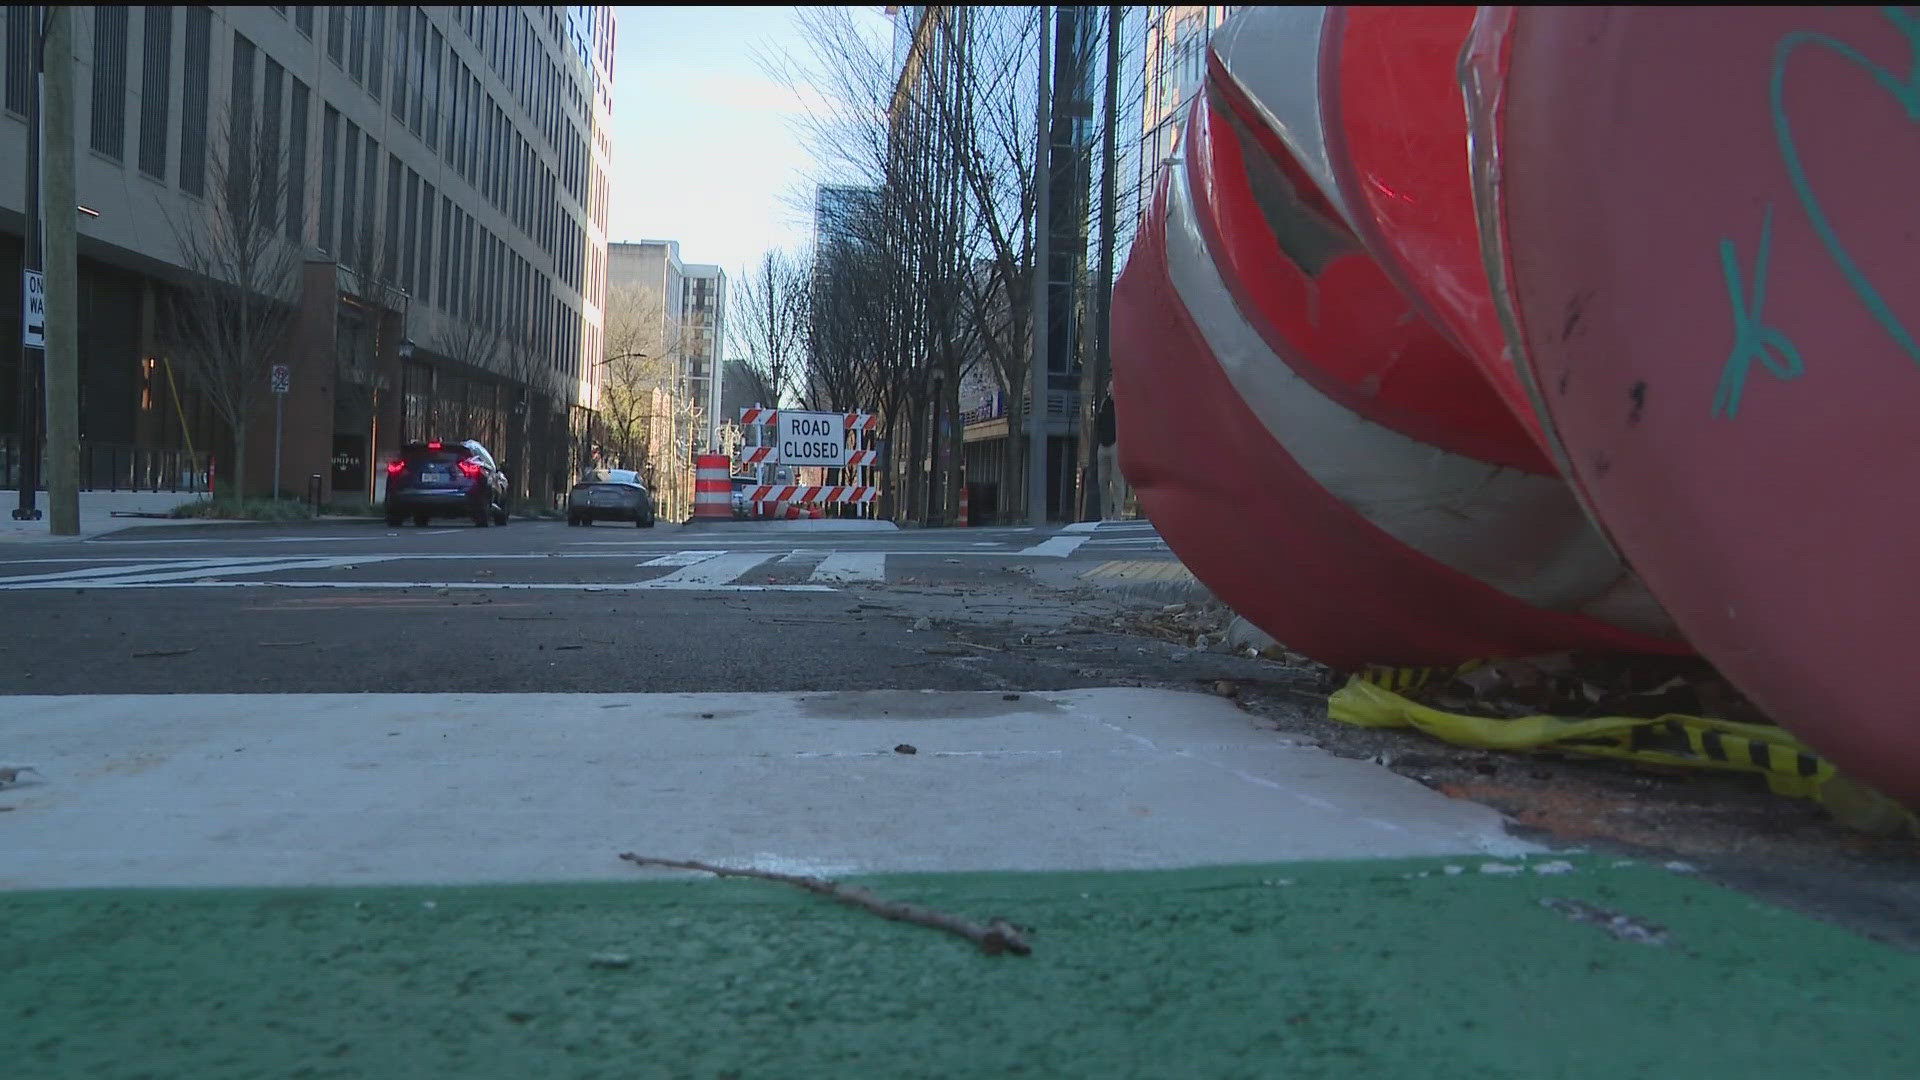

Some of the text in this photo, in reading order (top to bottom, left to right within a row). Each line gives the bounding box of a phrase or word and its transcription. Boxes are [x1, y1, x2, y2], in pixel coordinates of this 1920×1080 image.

[29, 276, 44, 295] ON
[30, 297, 44, 315] WA
[791, 419, 831, 436] ROAD
[784, 441, 839, 459] CLOSED
